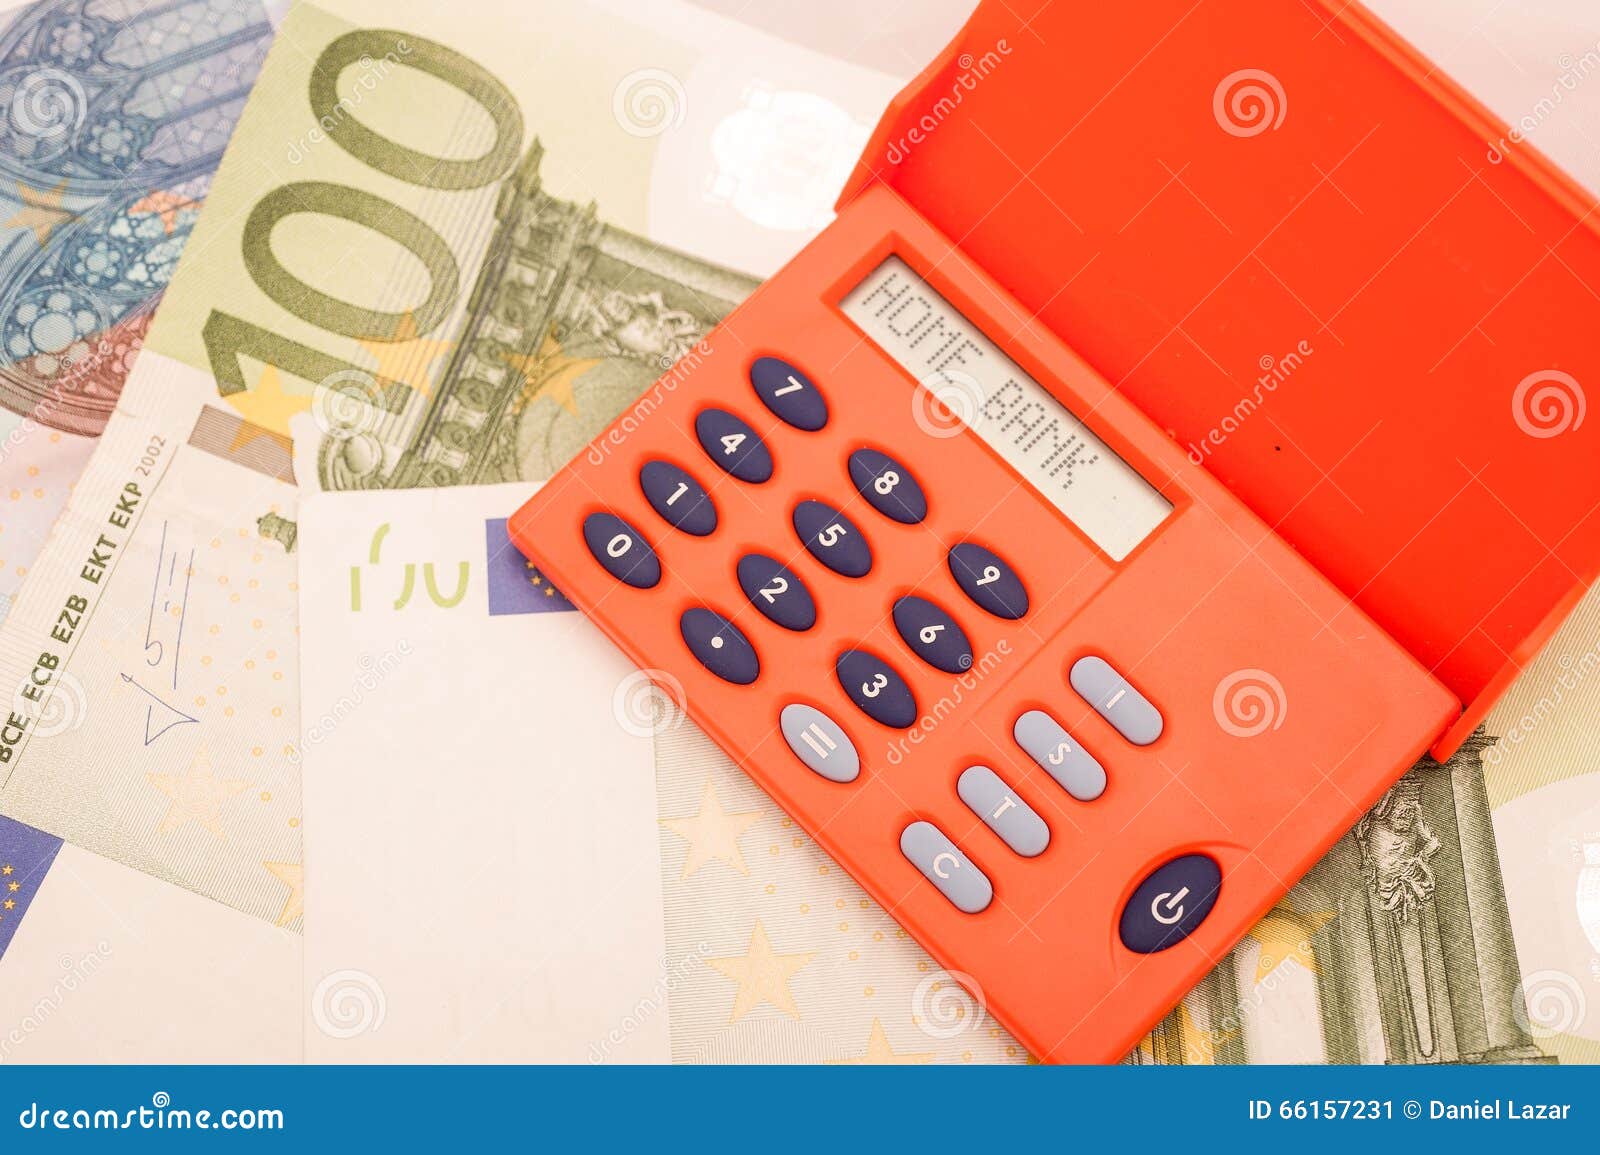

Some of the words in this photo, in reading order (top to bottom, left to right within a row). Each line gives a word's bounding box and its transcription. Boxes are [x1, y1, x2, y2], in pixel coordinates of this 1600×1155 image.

[202, 28, 525, 415] 100
[774, 375, 804, 397] 7
[874, 470, 900, 495] 8
[975, 565, 1001, 586] 9
[861, 272, 985, 384] HOME
[978, 378, 1100, 489] BANK
[0, 711, 31, 764] BCE
[21, 652, 60, 703] ECB
[50, 594, 88, 644] EZB
[80, 534, 118, 585] EKT
[108, 481, 142, 529] EKP
[135, 435, 167, 477] 2002
[606, 533, 633, 558] 0
[666, 482, 689, 506] 1
[758, 576, 789, 604] 2
[861, 673, 888, 698] 3
[719, 433, 747, 456] 4
[818, 523, 847, 547] 5
[919, 624, 945, 644] 6
[992, 796, 1018, 819] T
[1048, 742, 1072, 765] S
[933, 852, 960, 879] C
